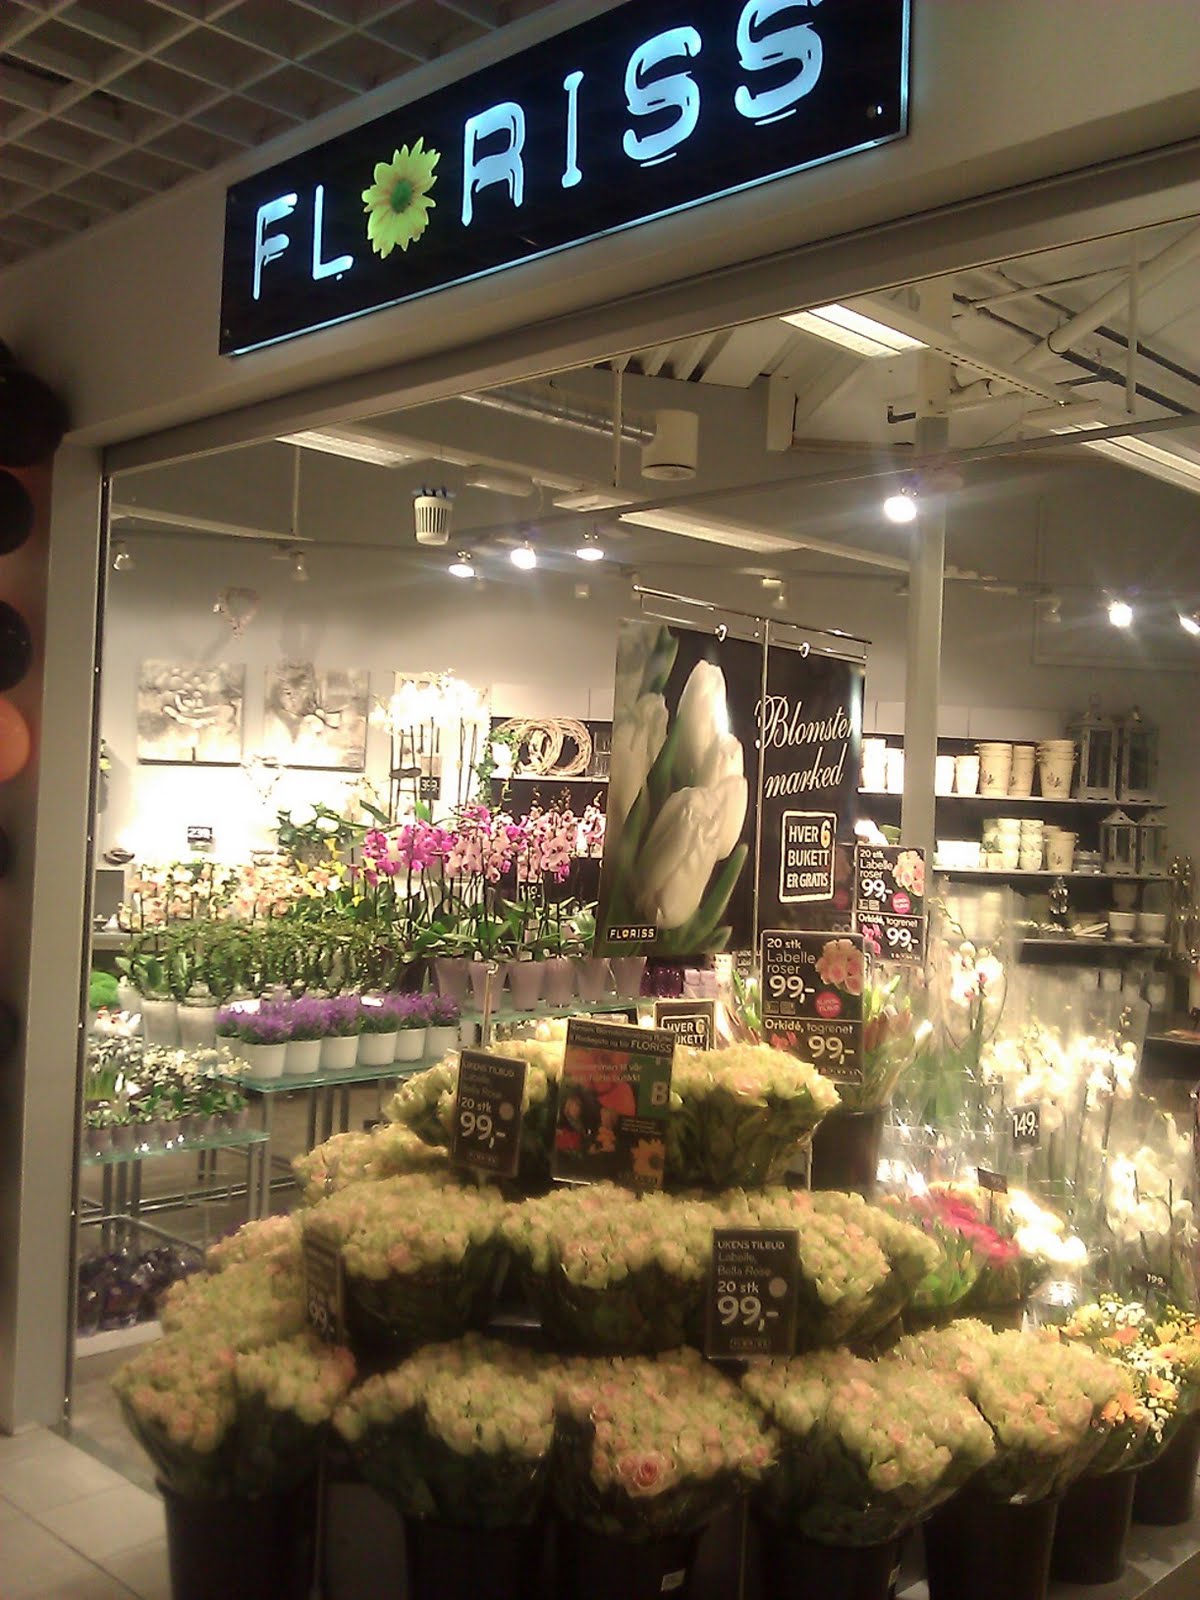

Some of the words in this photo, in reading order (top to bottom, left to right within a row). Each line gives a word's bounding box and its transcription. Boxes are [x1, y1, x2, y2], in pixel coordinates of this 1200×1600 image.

[765, 742, 847, 798] marked
[788, 825, 819, 843] HVER
[820, 820, 832, 849] 6
[787, 849, 830, 867] BUKETT
[860, 849, 872, 858] 20
[860, 859, 893, 870] Labelle
[786, 872, 799, 888] ER
[799, 872, 828, 888] GRATIS
[860, 870, 883, 878] roser
[861, 879, 893, 902] 99,-
[767, 938, 782, 948] 20
[785, 939, 802, 949] stk
[886, 927, 919, 952] 99,-
[767, 950, 816, 964] Labelle
[767, 964, 800, 974] roser
[769, 975, 815, 1004] 99,-
[765, 1019, 804, 1033] Orkidé,
[806, 1023, 853, 1034] togrenet
[631, 1040, 672, 1053] FLORISS
[808, 1035, 854, 1065] 99,-
[461, 1097, 475, 1109] 20
[460, 1111, 506, 1149] 99,-
[717, 1240, 750, 1250] UKENS
[751, 1241, 785, 1250] TILBUD
[717, 1281, 737, 1293] 20
[740, 1281, 759, 1294] stk
[717, 1295, 780, 1332] 99,-
